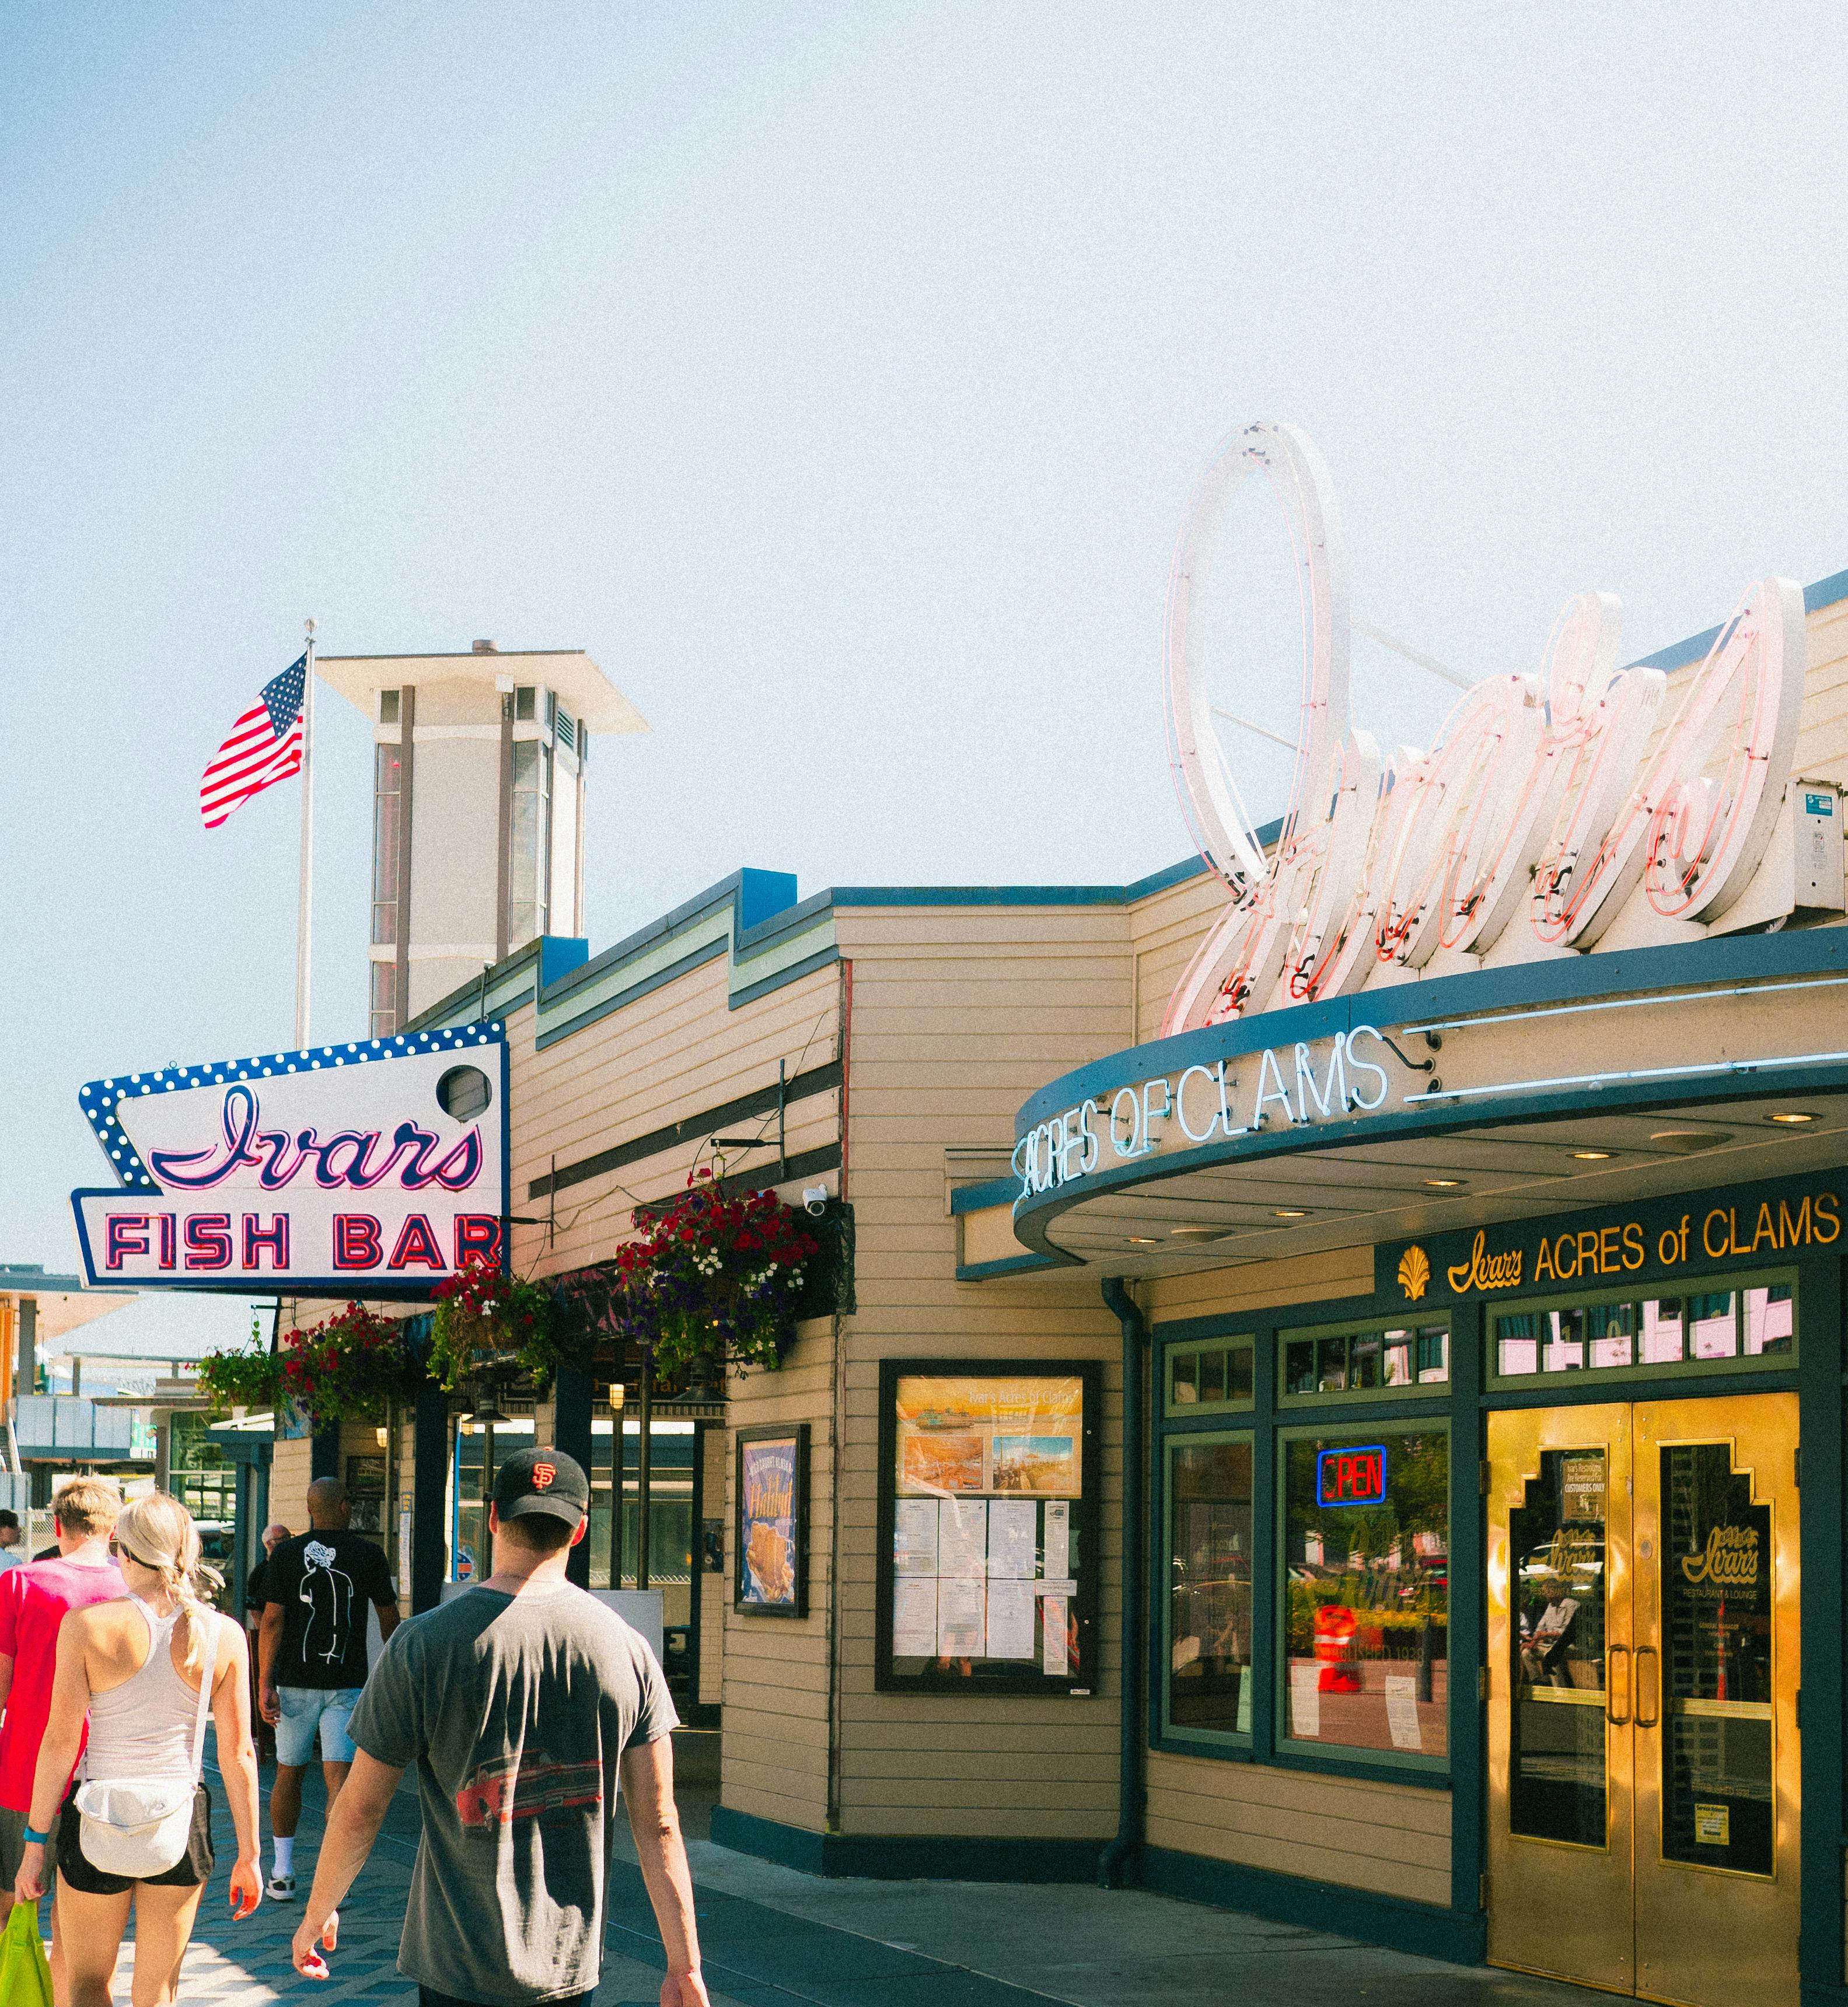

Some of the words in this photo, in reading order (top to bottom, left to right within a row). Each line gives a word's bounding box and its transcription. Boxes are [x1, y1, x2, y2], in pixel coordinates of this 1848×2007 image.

[1015, 1098, 1099, 1193] ACRES
[1110, 1078, 1172, 1159] OF
[1176, 1025, 1388, 1142] CLAMS
[105, 1212, 290, 1270] FISH
[332, 1212, 503, 1271] BAR
[1447, 1229, 1523, 1293] Ivar's
[1533, 1222, 1645, 1282] ACRES
[1658, 1214, 1691, 1265] of
[1702, 1191, 1841, 1258] CLAMS
[998, 1390, 1028, 1404] Acres
[1029, 1390, 1040, 1403] of
[1321, 1454, 1382, 1499] OPEN
[1564, 1483, 1592, 1493] CUSTOMERS
[1592, 1482, 1605, 1492] ONLY
[1681, 1525, 1759, 1585] Ivar's
[1682, 1588, 1723, 1599] RESTAURANT
[1730, 1590, 1758, 1601] LOUNGE
